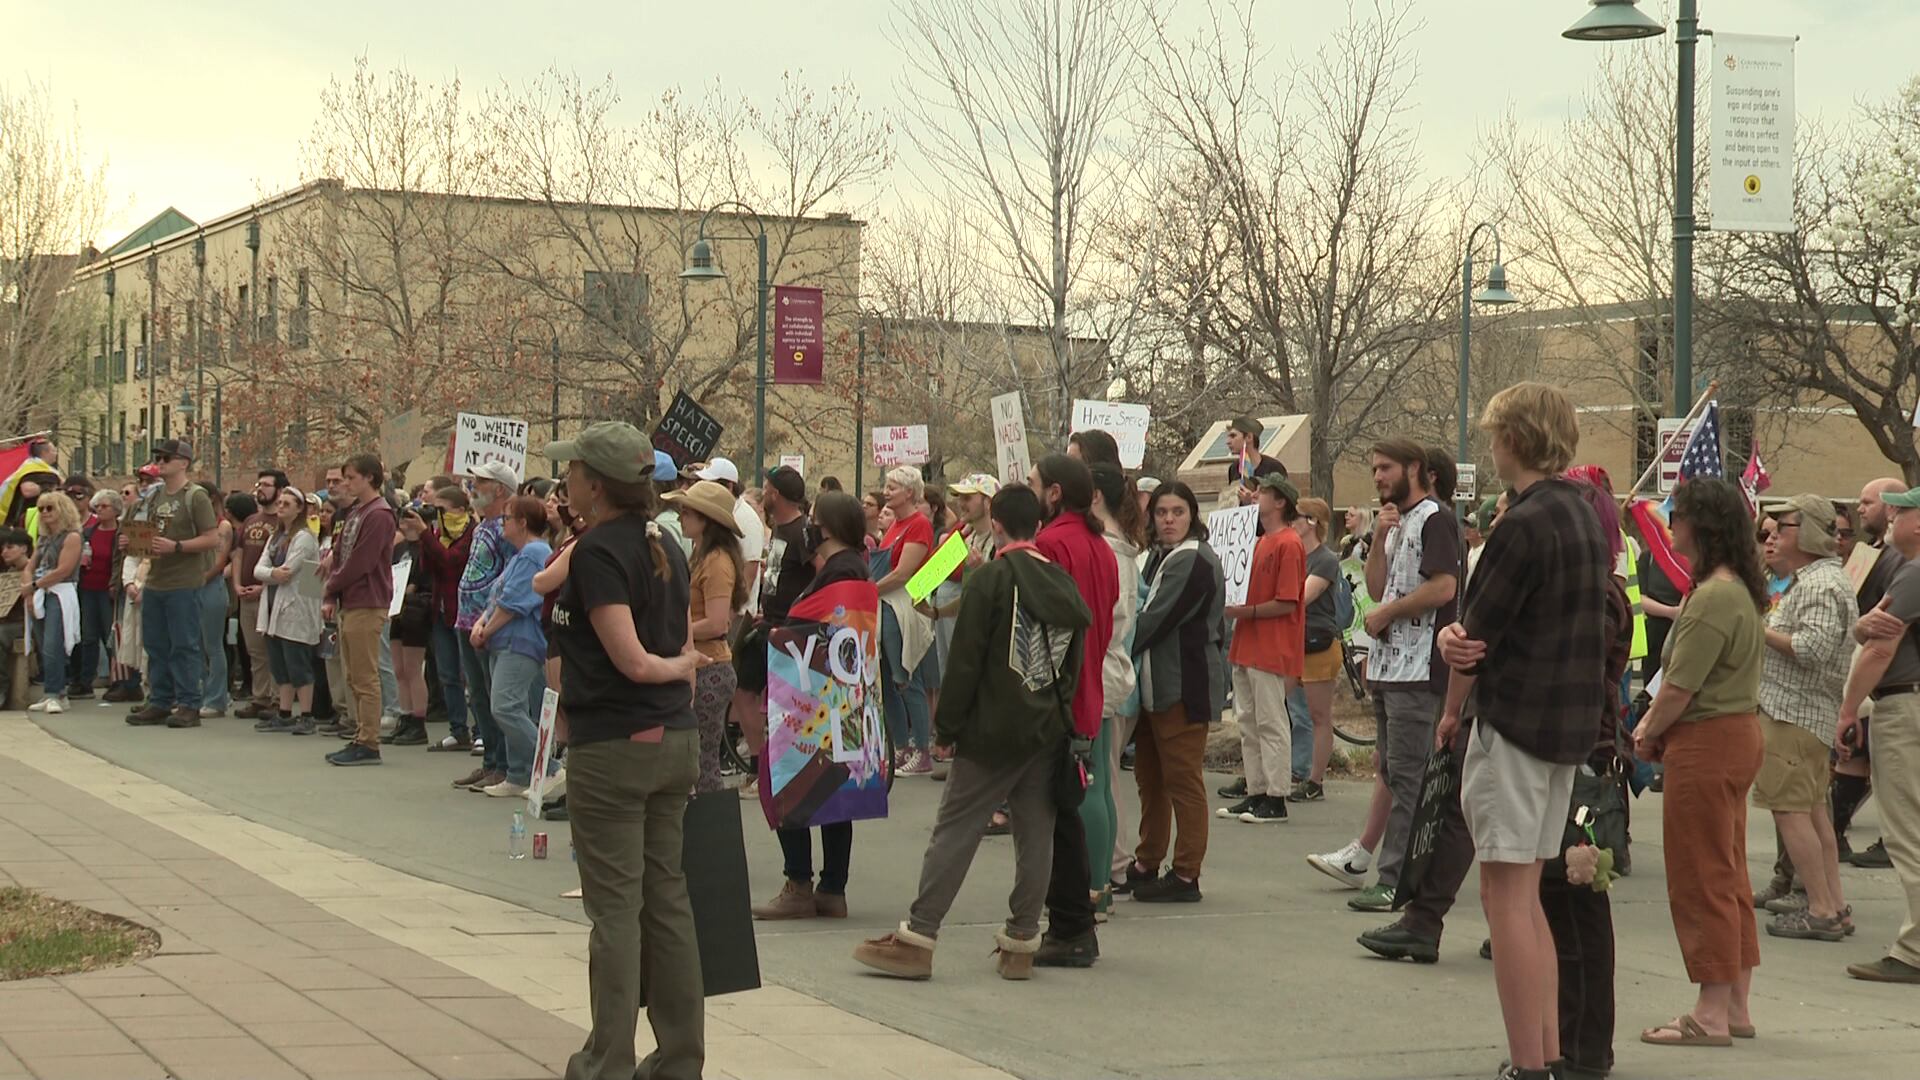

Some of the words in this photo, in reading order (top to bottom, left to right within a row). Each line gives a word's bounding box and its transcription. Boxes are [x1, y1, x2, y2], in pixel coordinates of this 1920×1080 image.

[1726, 85, 1762, 98] Suspending
[1764, 87, 1780, 97] one's
[1727, 102, 1739, 111] ego
[1741, 102, 1751, 111] and
[1753, 102, 1770, 112] pride
[1771, 103, 1779, 111] to
[1729, 116, 1759, 125] recognize
[1761, 116, 1775, 125] that
[1734, 129, 1748, 138] idea
[1750, 130, 1755, 138] is
[1756, 131, 1779, 140] perfect
[1725, 143, 1736, 152] and
[1737, 142, 1755, 153] being
[1757, 145, 1771, 154] open
[1773, 145, 1779, 153] to
[1722, 157, 1732, 167] the
[1734, 158, 1751, 168] input
[1752, 158, 1759, 168] of
[1001, 400, 1014, 419] NO
[1082, 407, 1113, 425] HATE
[462, 416, 477, 430] NO
[485, 420, 525, 438] WHITE
[674, 398, 718, 441] HATE
[660, 417, 708, 457] SPEECH
[890, 426, 909, 441] ONE
[465, 450, 480, 465] AT
[785, 627, 880, 692] YOU
